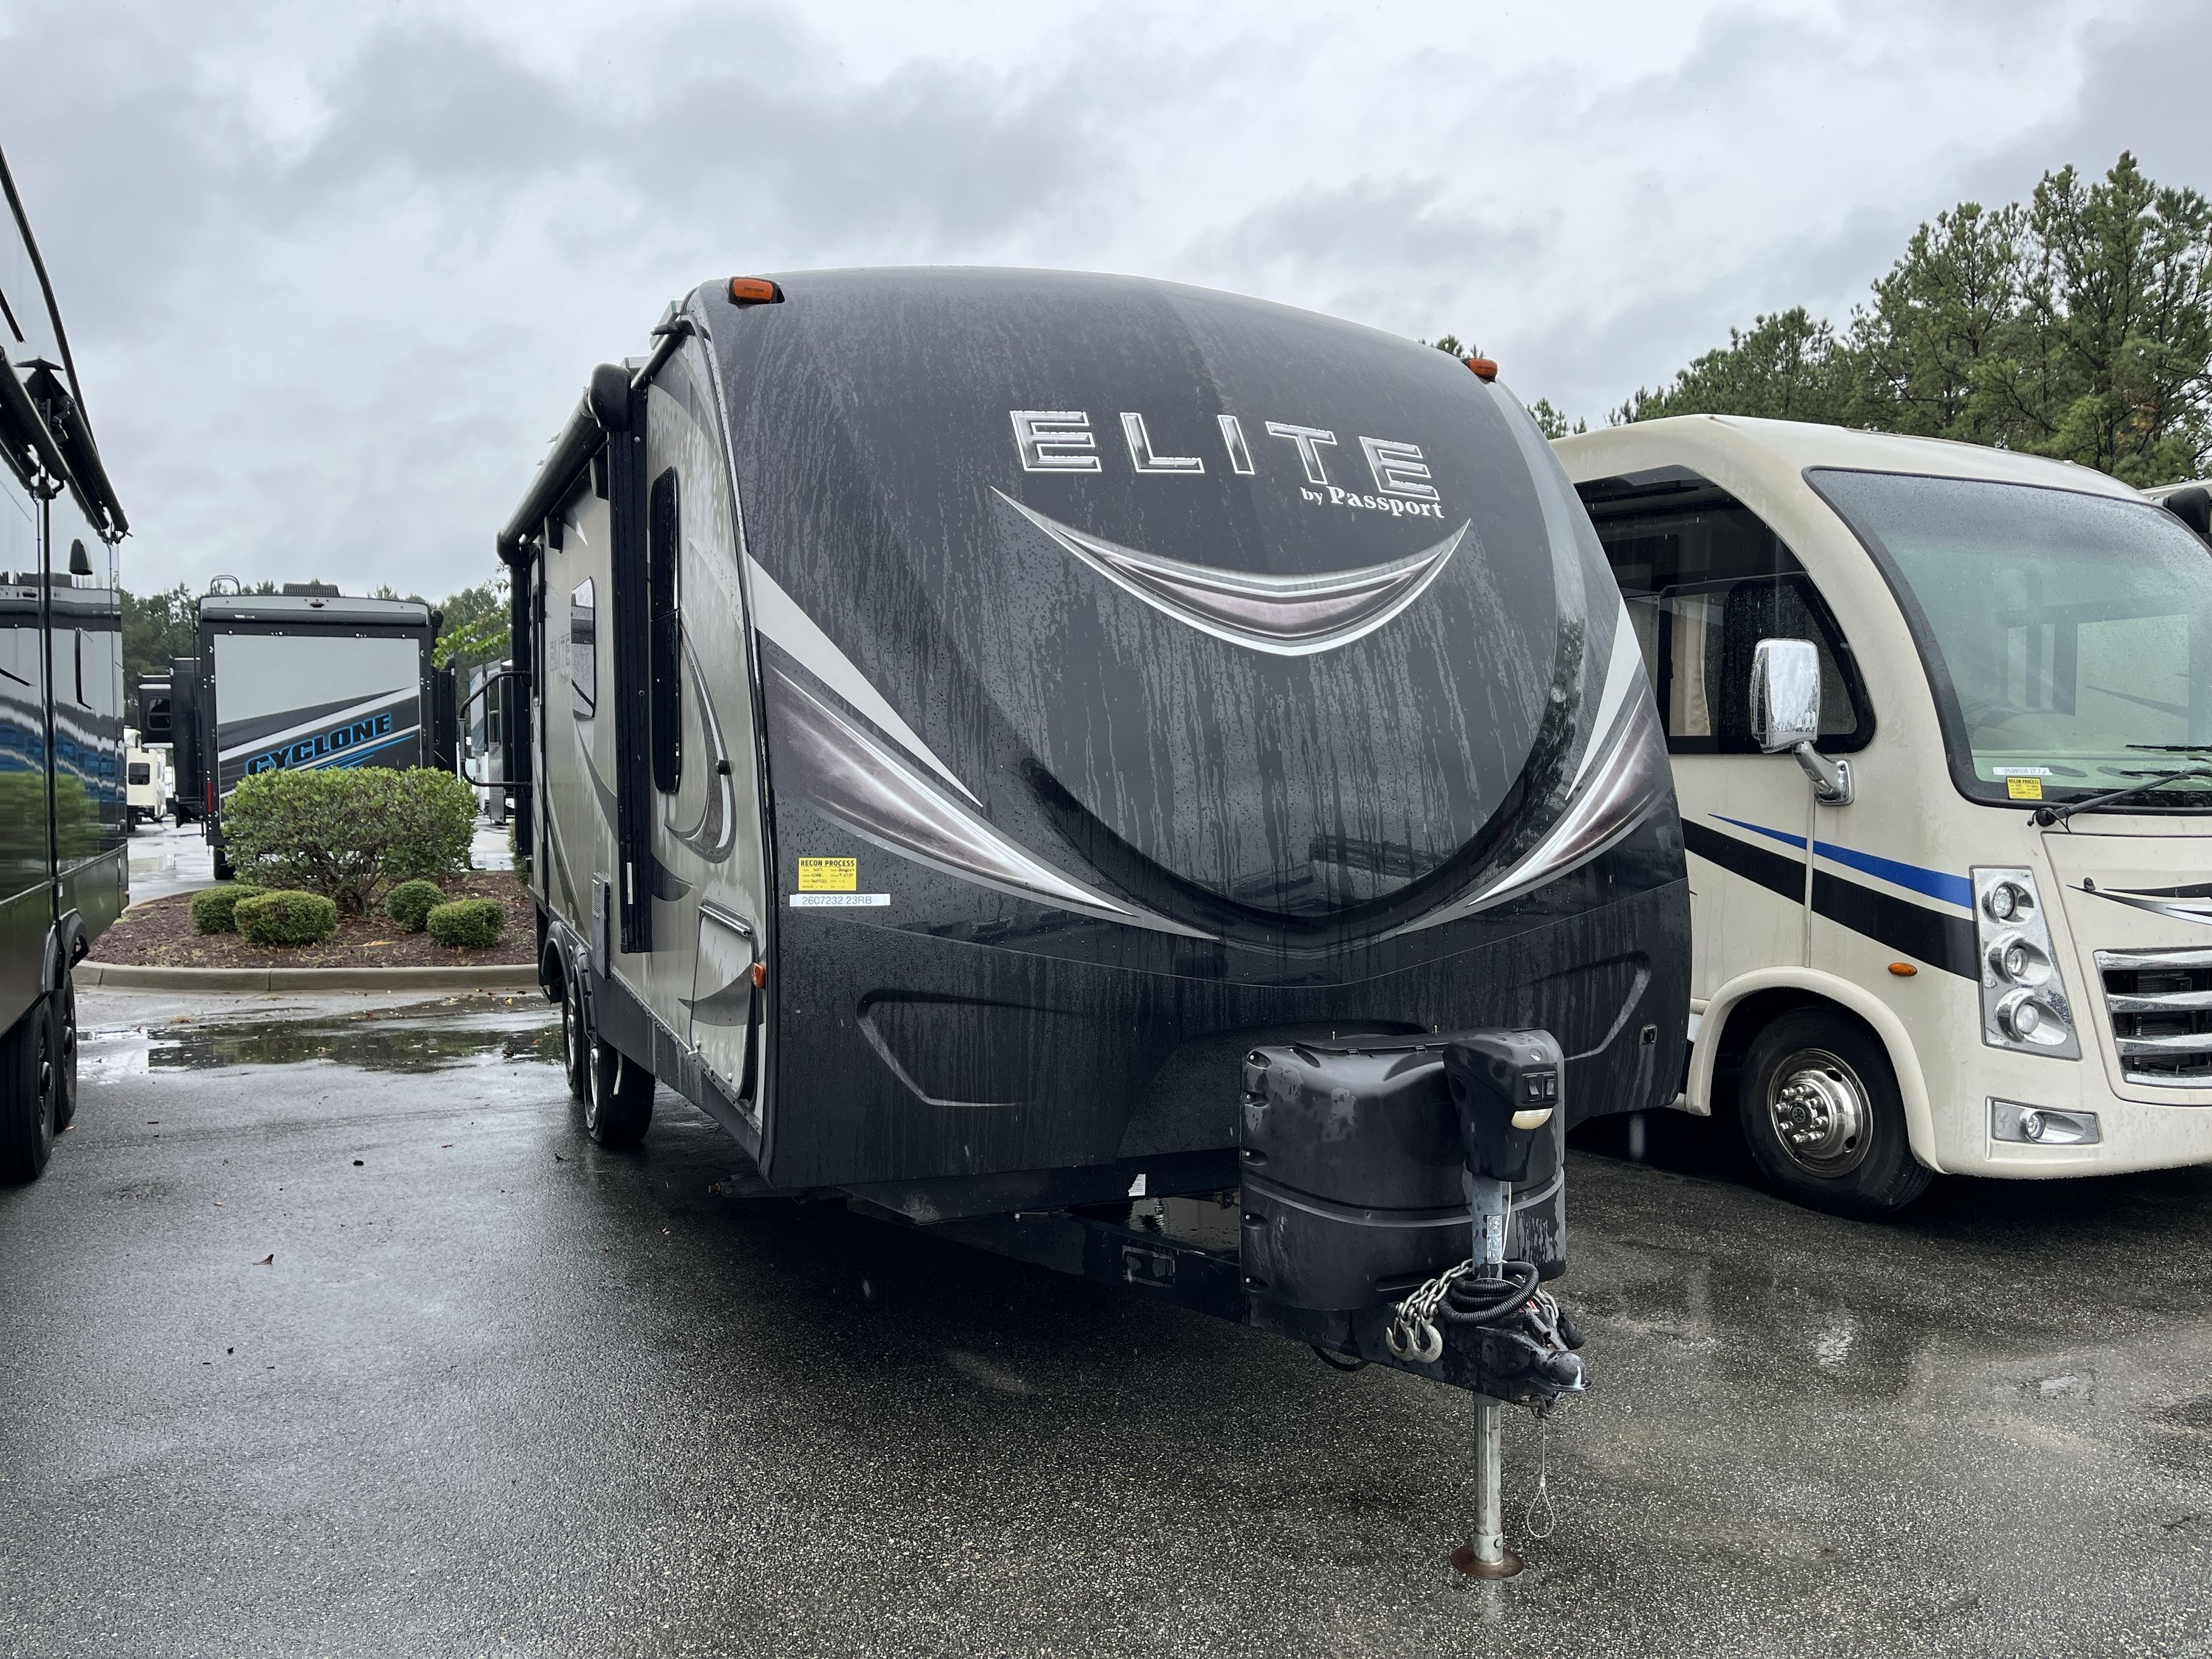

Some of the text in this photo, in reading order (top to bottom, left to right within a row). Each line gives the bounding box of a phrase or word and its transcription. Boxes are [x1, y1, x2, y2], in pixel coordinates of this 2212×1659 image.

[1009, 410, 1440, 501] ELITE
[1300, 485, 1445, 518] by Passport
[246, 712, 392, 776] CYCLONE
[802, 896, 872, 905] 2607232 23RB
